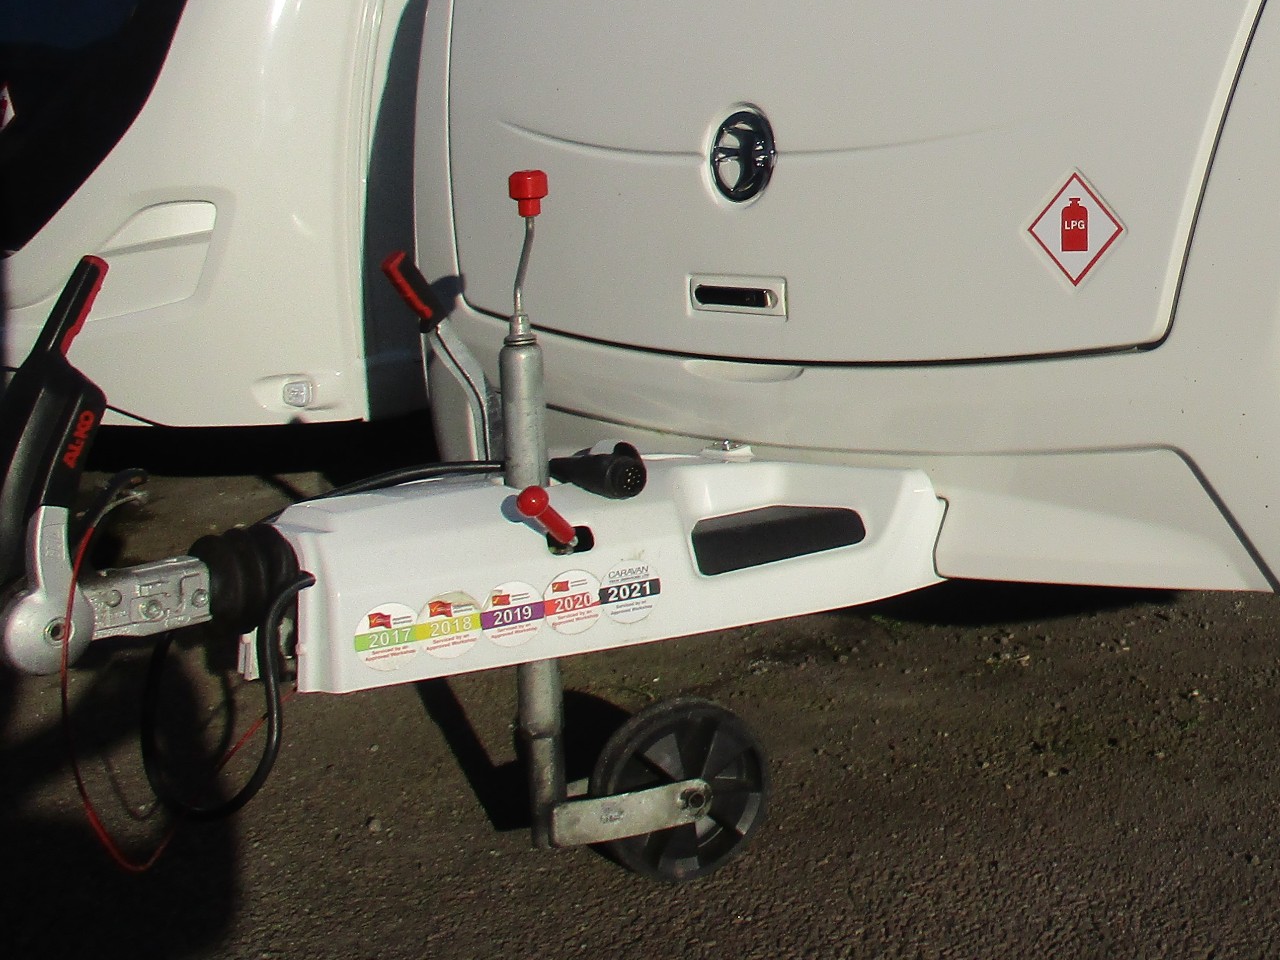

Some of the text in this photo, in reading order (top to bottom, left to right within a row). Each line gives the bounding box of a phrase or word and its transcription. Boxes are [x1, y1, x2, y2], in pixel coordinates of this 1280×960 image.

[1064, 220, 1085, 230] LPG
[608, 565, 649, 578] CARAVAN
[607, 581, 651, 602] 2021
[554, 592, 592, 613] 2020
[493, 605, 532, 625] 2019
[430, 616, 471, 637] 2018
[369, 627, 411, 649] 2017
